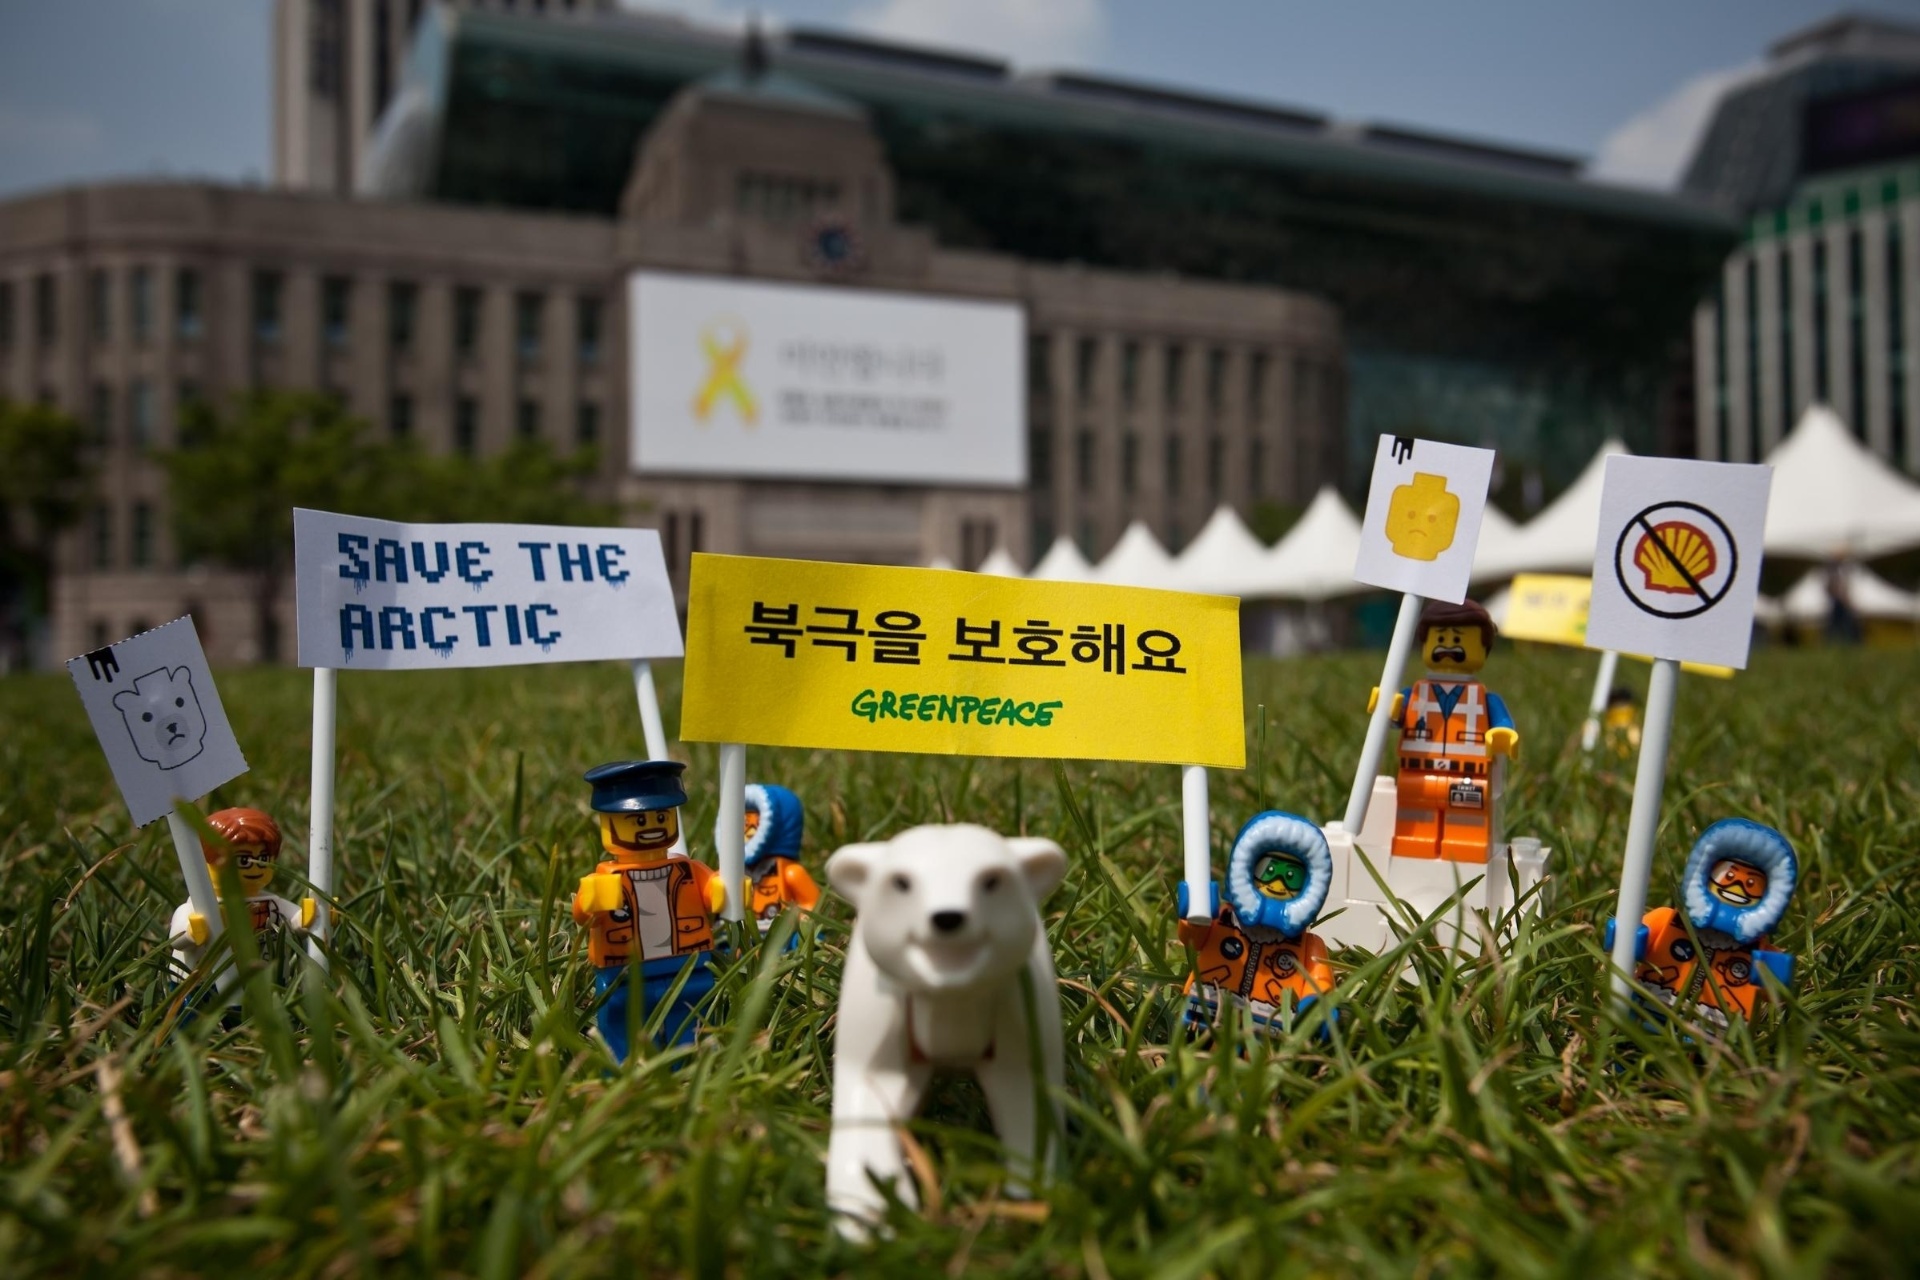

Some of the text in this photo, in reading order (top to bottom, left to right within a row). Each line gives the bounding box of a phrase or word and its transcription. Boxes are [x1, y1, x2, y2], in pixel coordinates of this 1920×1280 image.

[337, 531, 631, 588] SAVE THE
[338, 602, 562, 655] ARCTIC
[743, 600, 1187, 676] 북극을 보호해요
[851, 688, 1064, 728] GREENPEACE
